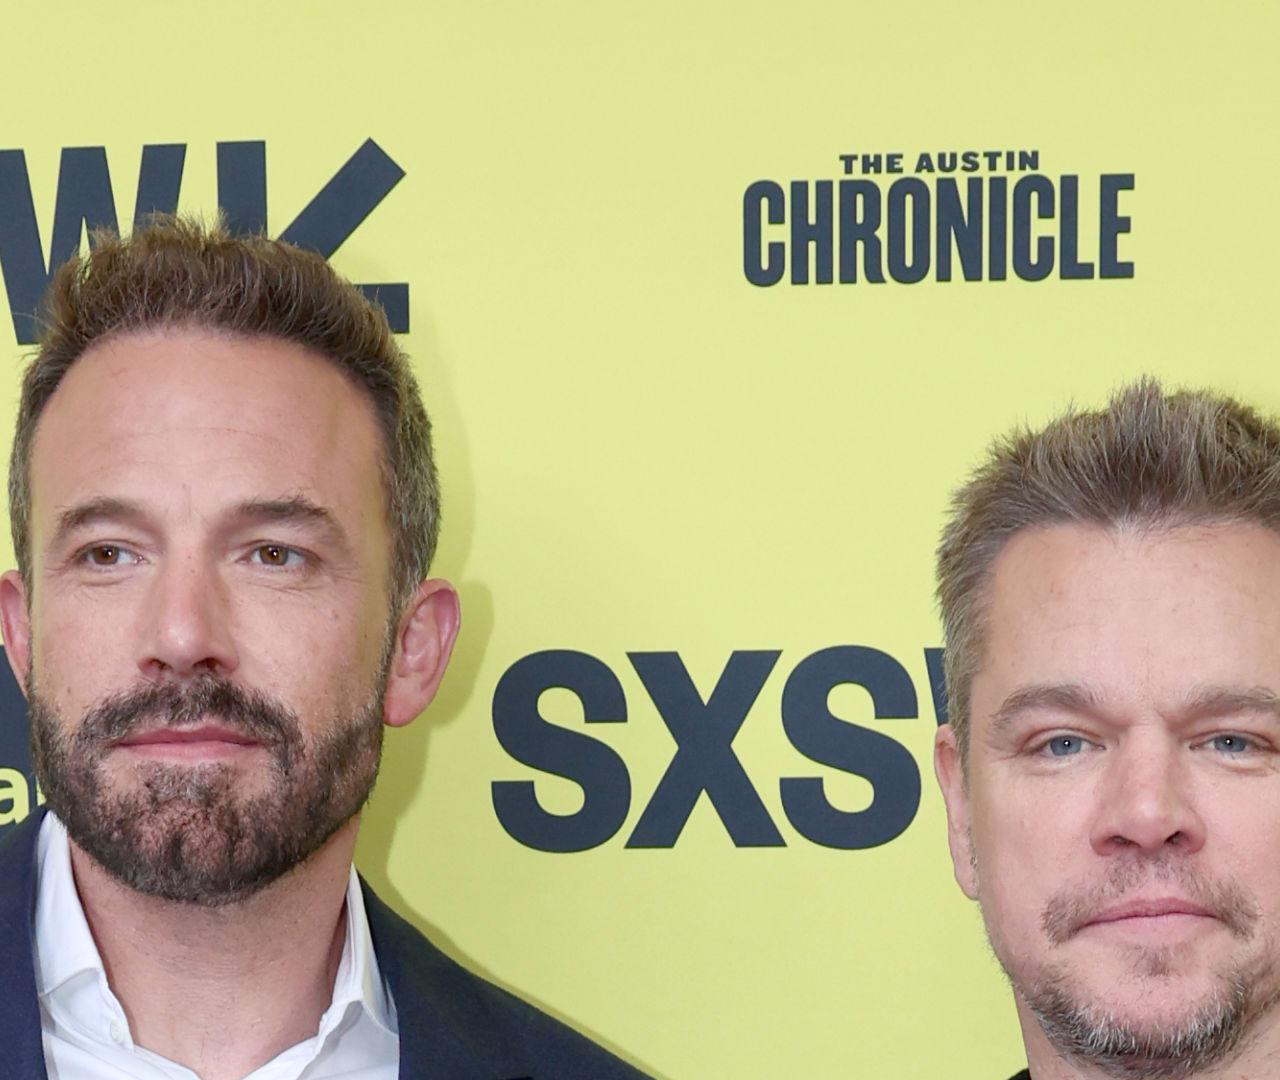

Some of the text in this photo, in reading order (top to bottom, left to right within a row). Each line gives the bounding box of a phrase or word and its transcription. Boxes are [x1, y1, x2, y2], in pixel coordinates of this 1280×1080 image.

[839, 150, 1039, 174] THE AUSTIN
[743, 173, 1135, 288] CHRONICLE
[490, 644, 950, 854] SXS
